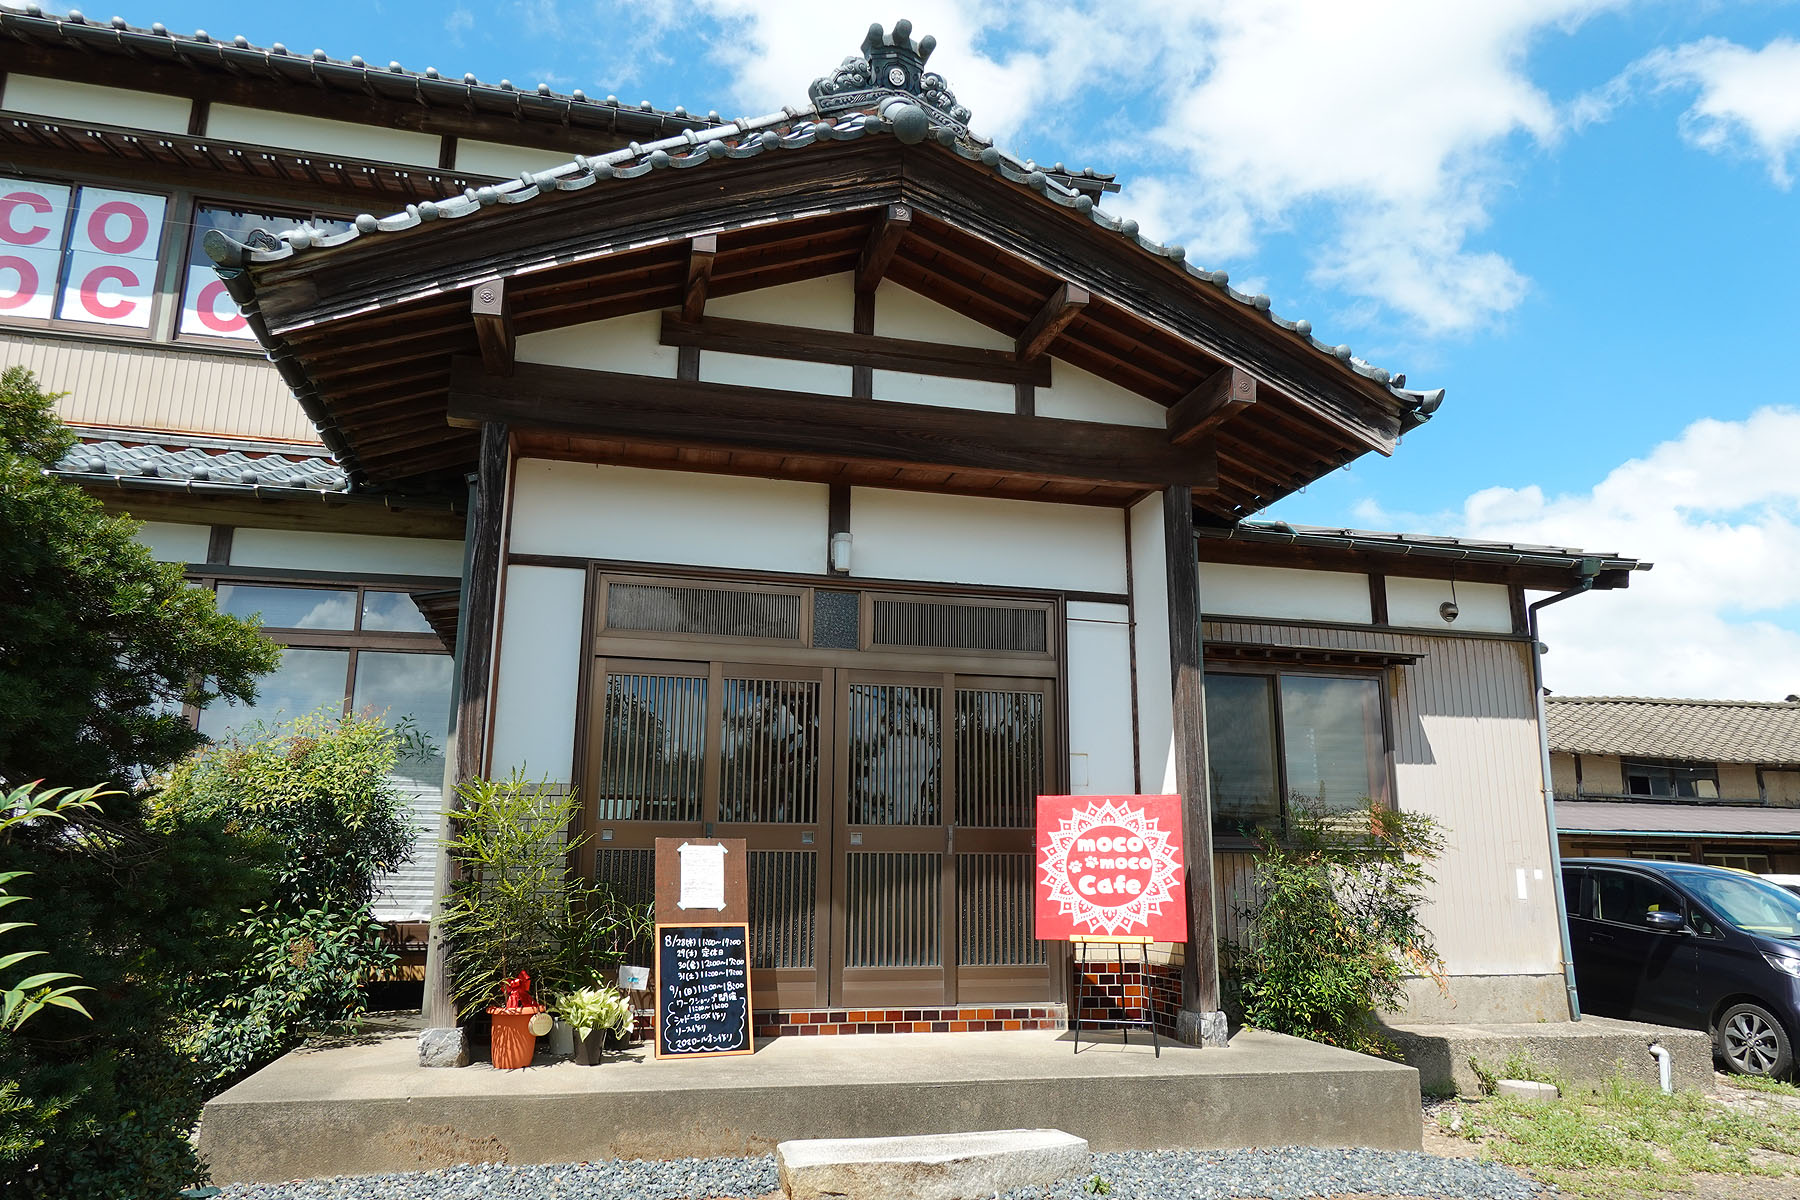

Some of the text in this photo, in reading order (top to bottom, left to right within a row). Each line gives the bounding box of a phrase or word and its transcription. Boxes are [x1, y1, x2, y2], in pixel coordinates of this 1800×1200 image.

[1078, 874, 1142, 896] Cafe
[701, 947, 724, 958] 定休日
